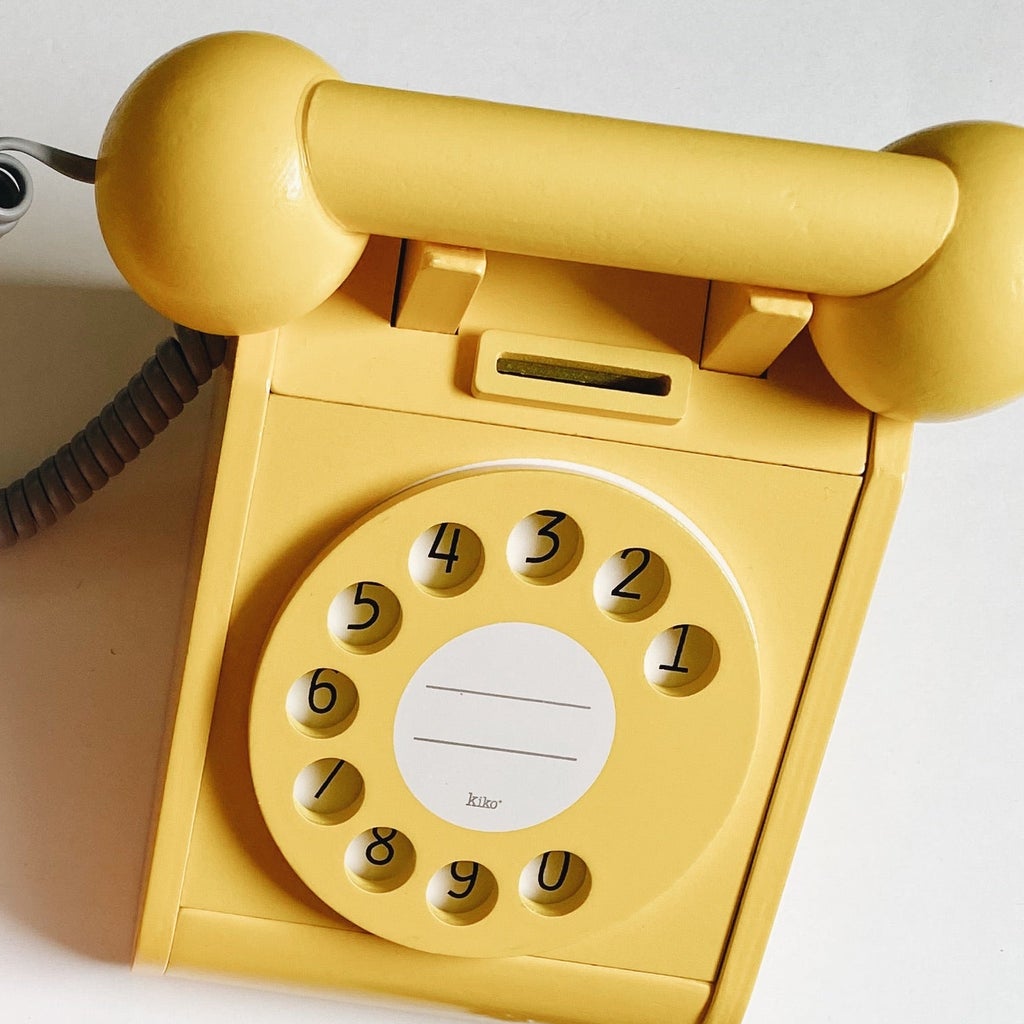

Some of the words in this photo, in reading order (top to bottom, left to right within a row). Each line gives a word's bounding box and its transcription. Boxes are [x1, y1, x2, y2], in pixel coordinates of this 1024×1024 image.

[427, 522, 461, 573] 4
[525, 509, 567, 564] 3
[611, 547, 651, 600] 2
[347, 581, 380, 630] 5
[658, 624, 690, 673] 1
[307, 668, 340, 714] 6
[466, 792, 498, 809] kiko
[365, 827, 398, 866] 8
[447, 861, 480, 899] 9
[537, 851, 571, 891] 0
